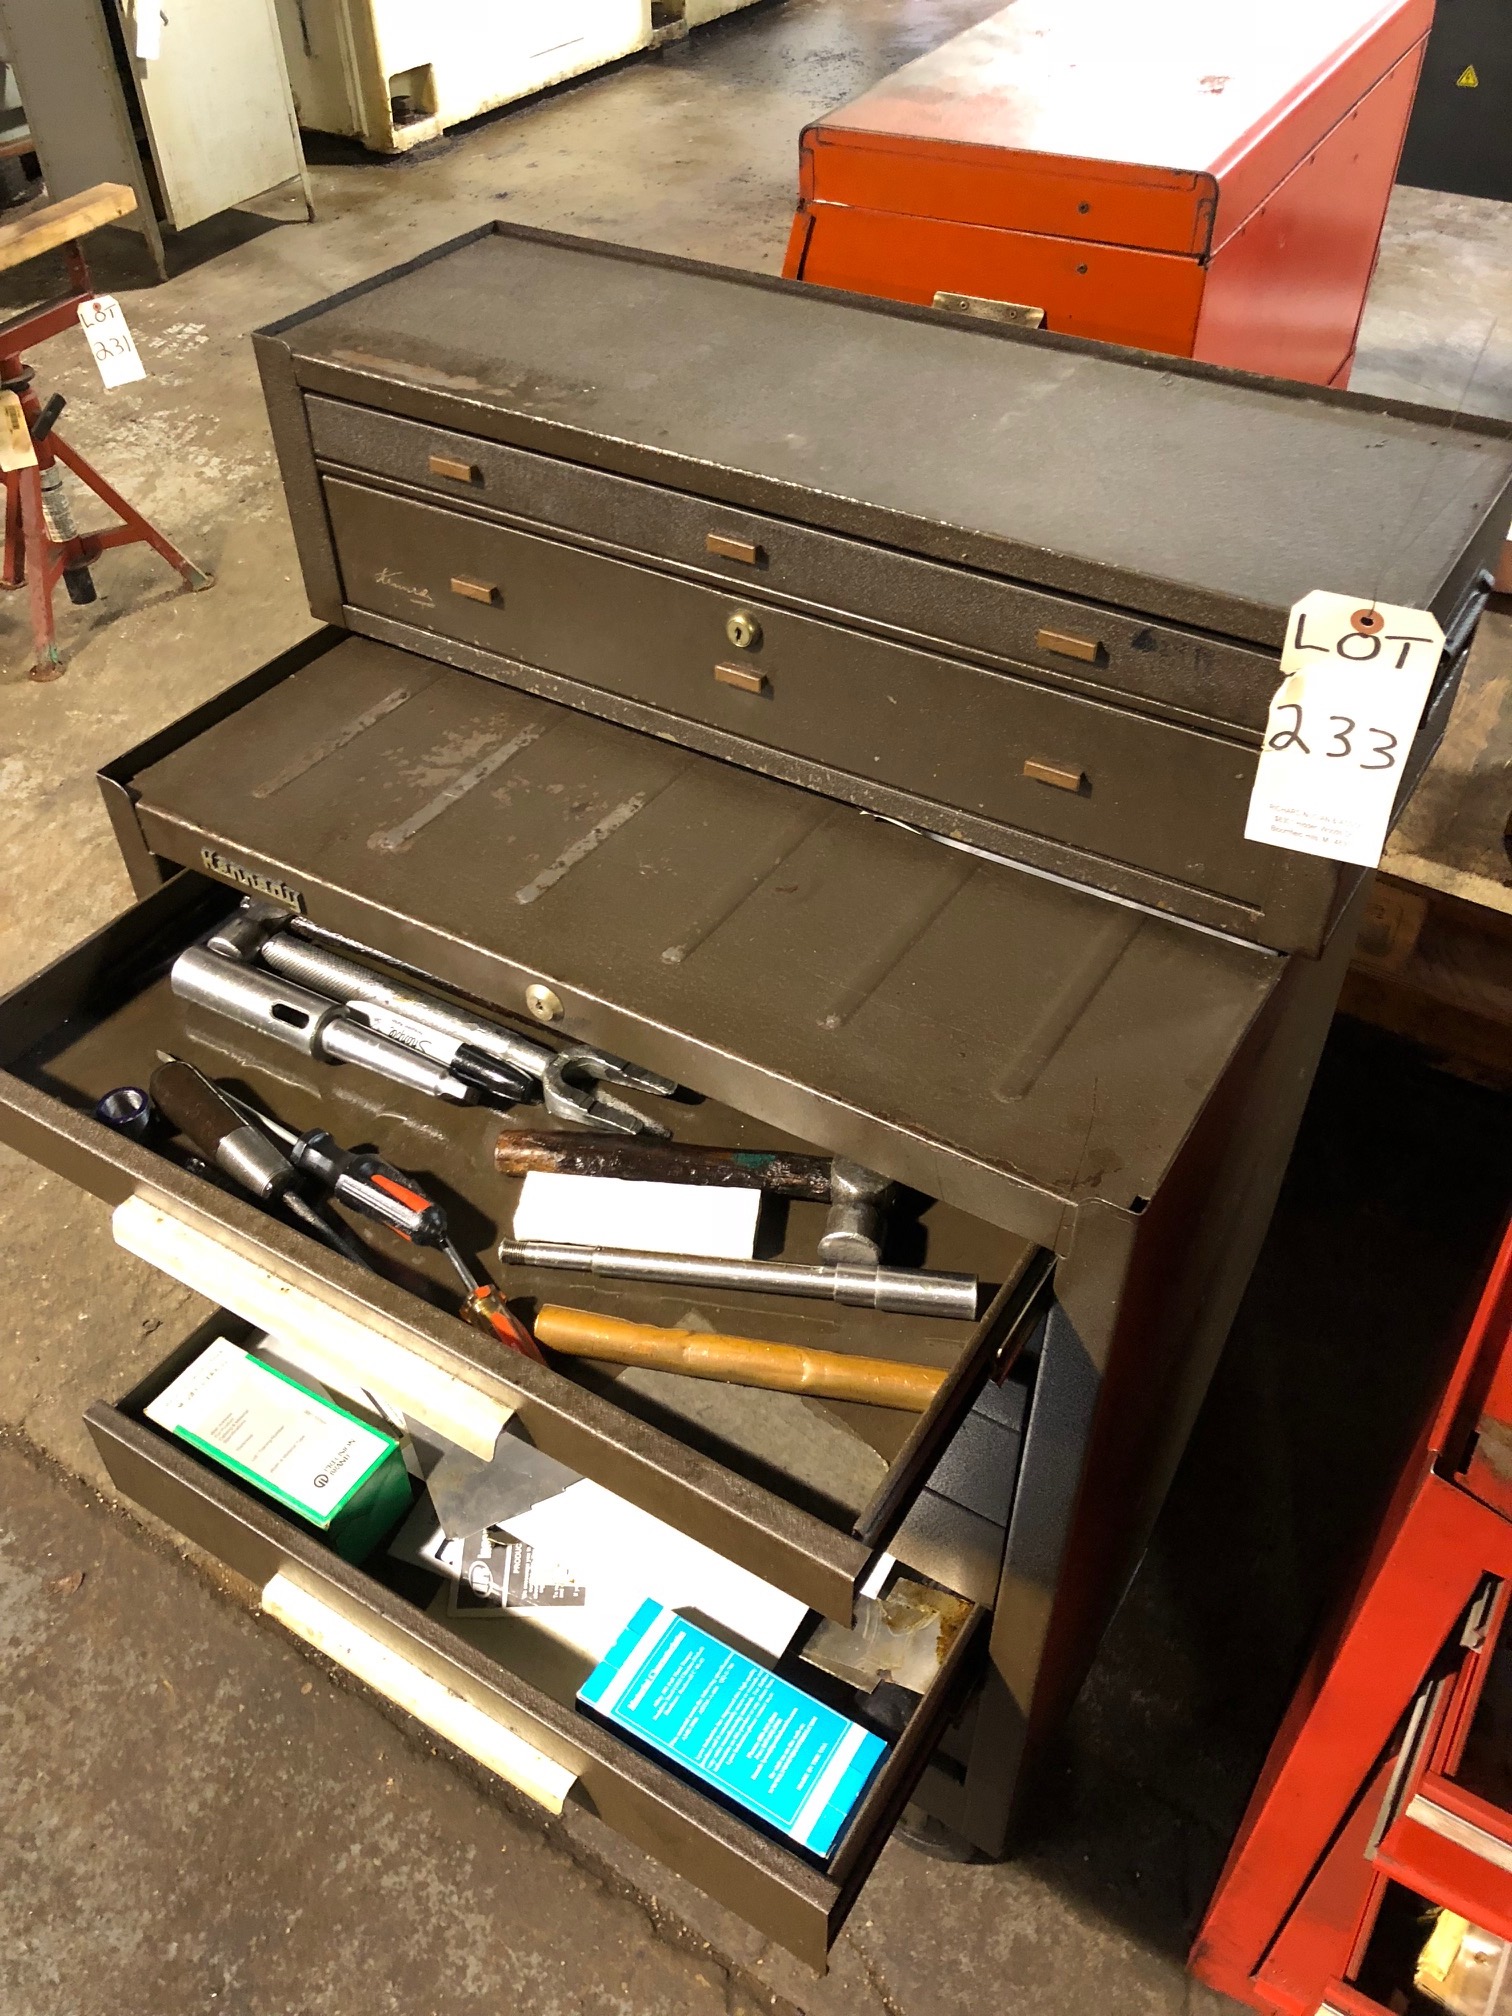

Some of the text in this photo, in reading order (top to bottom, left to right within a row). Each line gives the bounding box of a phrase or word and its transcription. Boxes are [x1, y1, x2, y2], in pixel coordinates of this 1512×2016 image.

[80, 303, 116, 328] LOT
[94, 335, 131, 361] 231
[1295, 613, 1433, 669] LOT
[1268, 704, 1398, 770] 233
[201, 847, 305, 914] Kennedy
[513, 1543, 522, 1574] PRODUC
